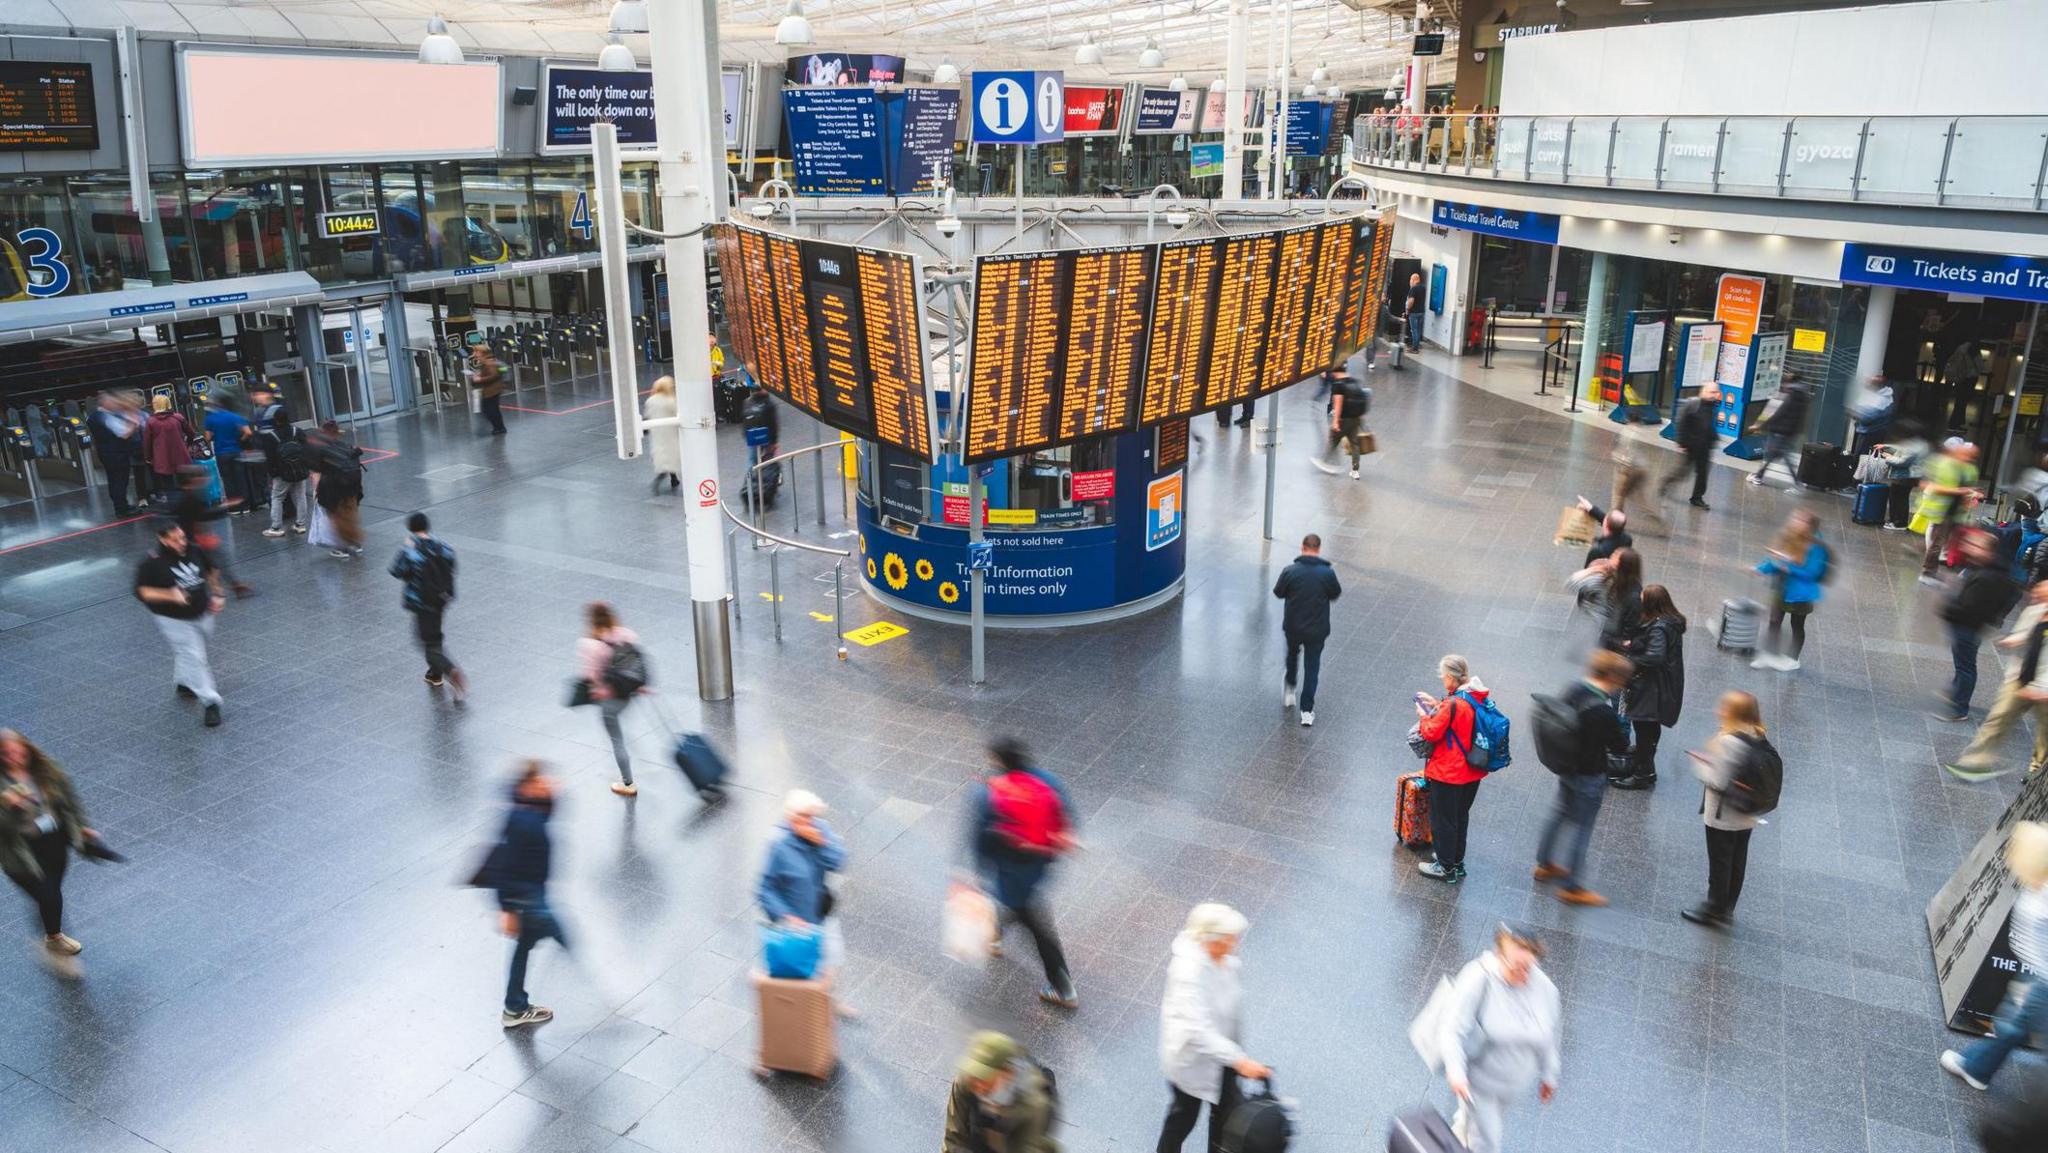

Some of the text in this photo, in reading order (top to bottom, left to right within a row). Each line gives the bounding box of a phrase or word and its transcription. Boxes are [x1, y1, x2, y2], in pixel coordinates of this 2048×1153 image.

[556, 85, 648, 101] The only time our
[555, 103, 648, 118] will look down on
[1504, 141, 1853, 165] sushi curry ramen gyoza
[570, 191, 593, 240] 4
[1450, 208, 1520, 230] Tickets and Travel Centre
[16, 227, 70, 297] 3
[1913, 260, 1977, 282] Tickets
[1982, 269, 2019, 286] and
[882, 497, 896, 506] Tickets
[913, 506, 922, 514] here
[1003, 537, 1019, 546] not
[1022, 536, 1040, 545] sold
[1043, 536, 1064, 545] here
[956, 562, 1073, 578] Trn Information
[963, 580, 1067, 596] Tin times only
[859, 626, 894, 640] EXIT
[1992, 956, 2017, 972] THE
